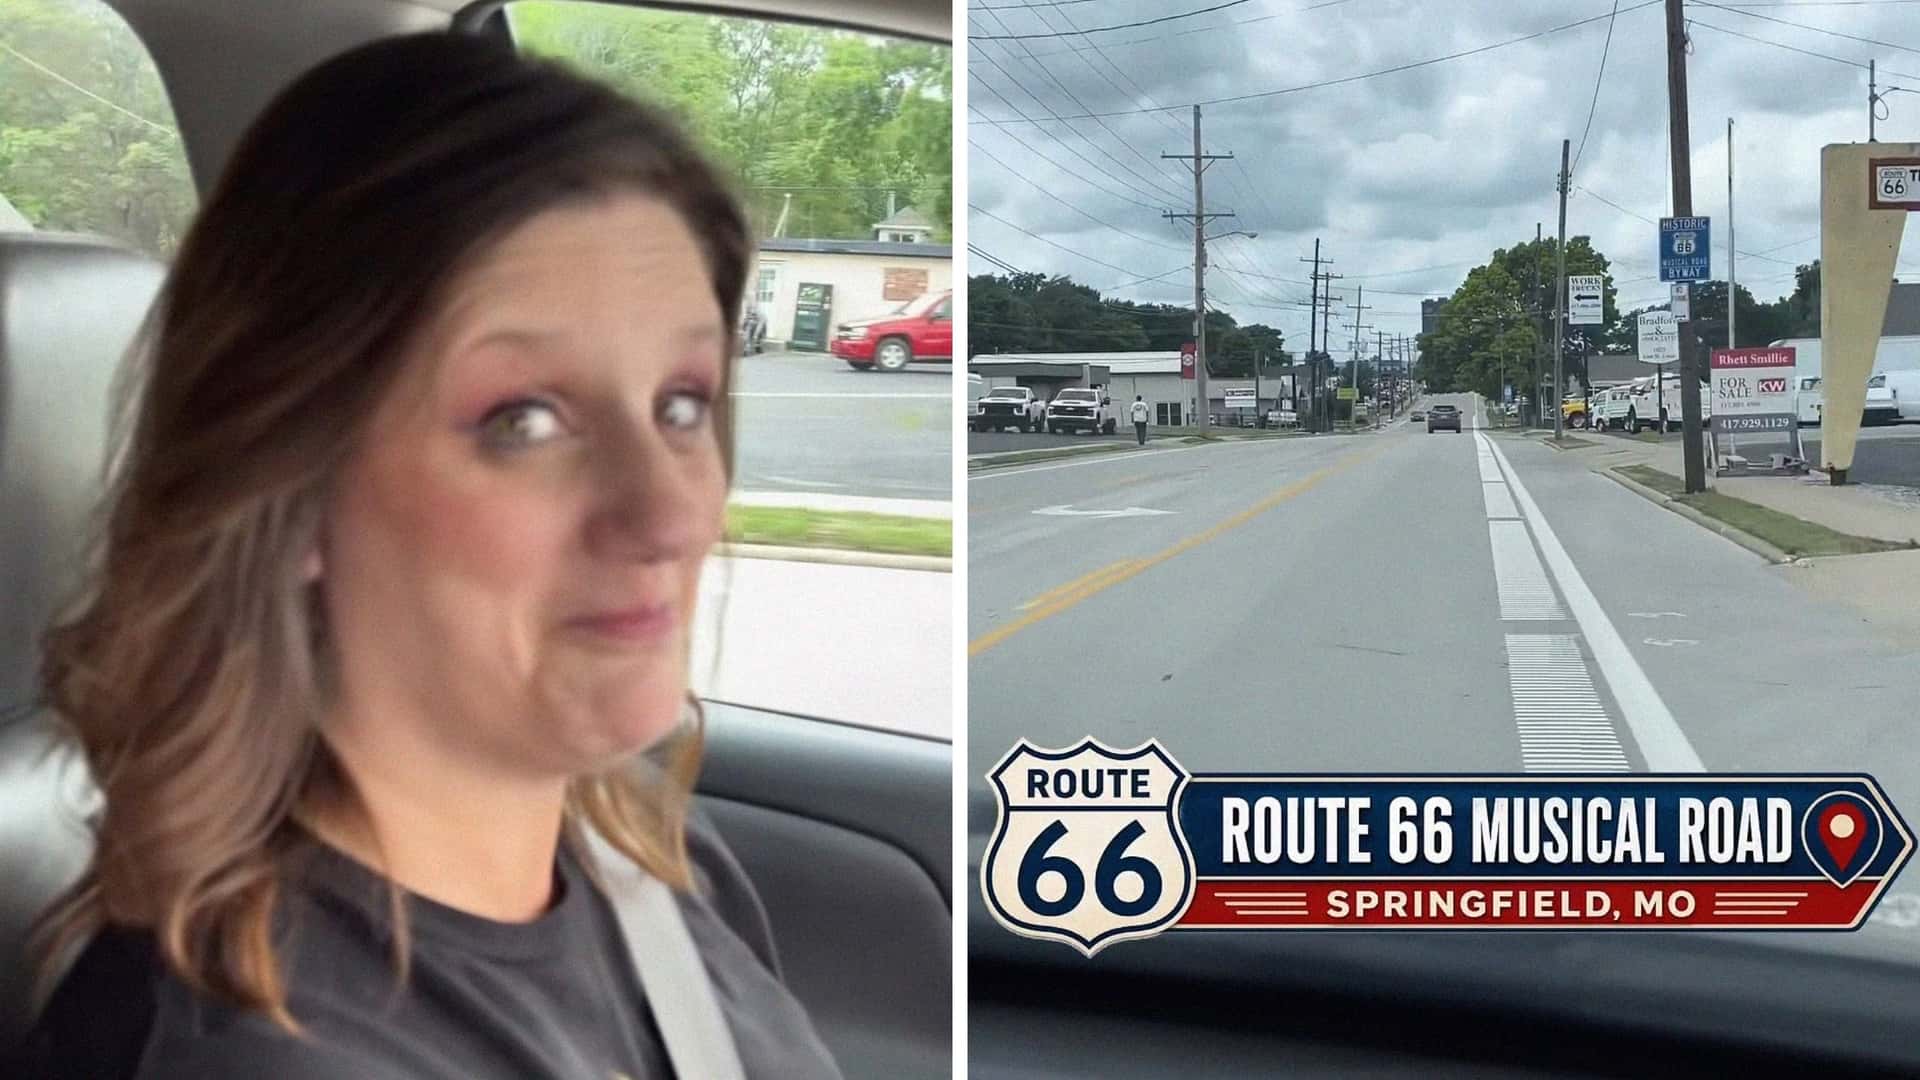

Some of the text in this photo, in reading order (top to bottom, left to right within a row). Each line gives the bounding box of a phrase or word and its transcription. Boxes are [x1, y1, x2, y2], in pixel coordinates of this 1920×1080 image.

[1884, 179, 1905, 195] 66
[1663, 219, 1706, 231] HISTORIC
[1677, 243, 1692, 253] 66
[1668, 267, 1701, 279] BYWAY
[1571, 277, 1600, 285] WORK
[1655, 325, 1664, 335] &
[1719, 353, 1788, 365] Rhett Smillie
[1720, 378, 1746, 388] FOR
[1759, 380, 1784, 392] KW
[1720, 388, 1752, 399] SALE
[1720, 417, 1790, 430] 417.929.1129
